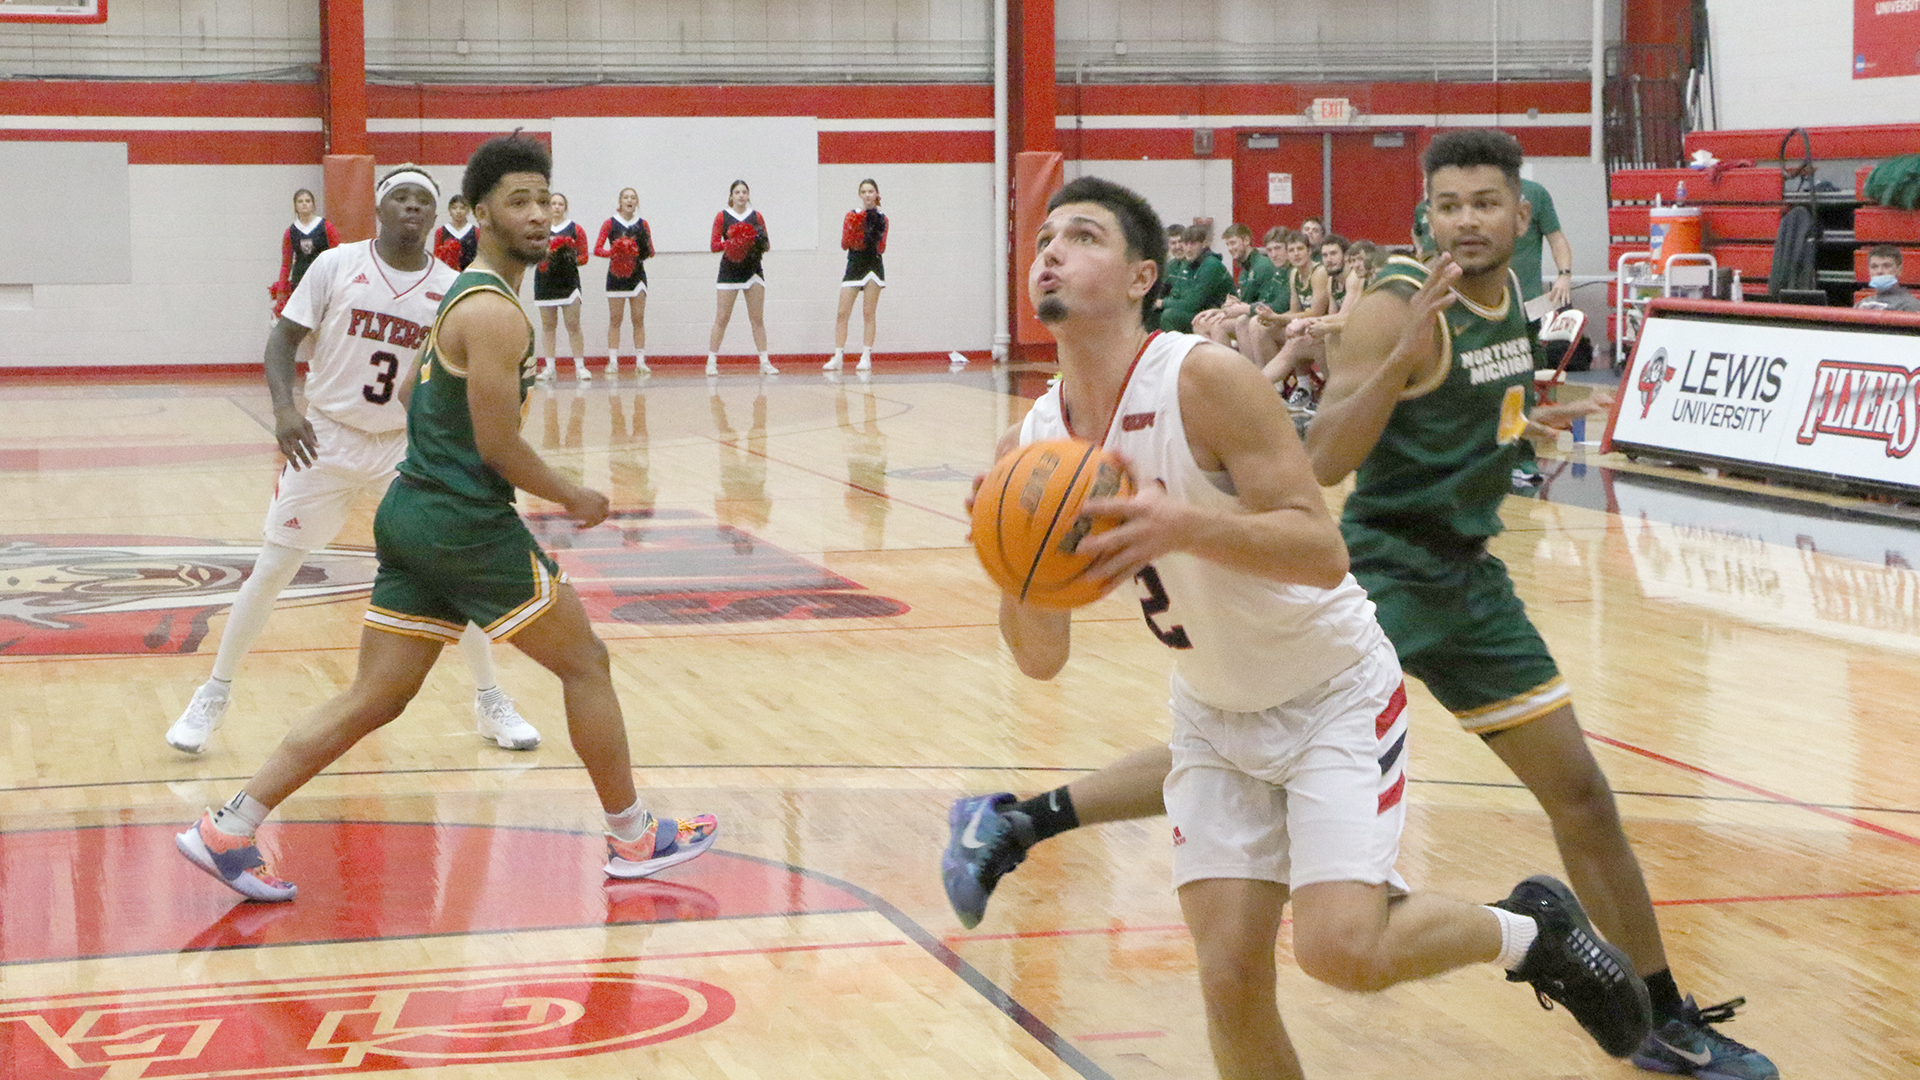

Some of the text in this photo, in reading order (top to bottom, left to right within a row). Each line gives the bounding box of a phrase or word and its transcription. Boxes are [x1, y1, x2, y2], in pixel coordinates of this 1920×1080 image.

[1321, 100, 1345, 118] EXIT
[362, 350, 399, 405] 3
[1679, 350, 1788, 403] LEWIS
[1672, 398, 1772, 433] UNIVERSITY
[1797, 359, 1920, 458] FLYERS
[1134, 565, 1194, 650] 2
